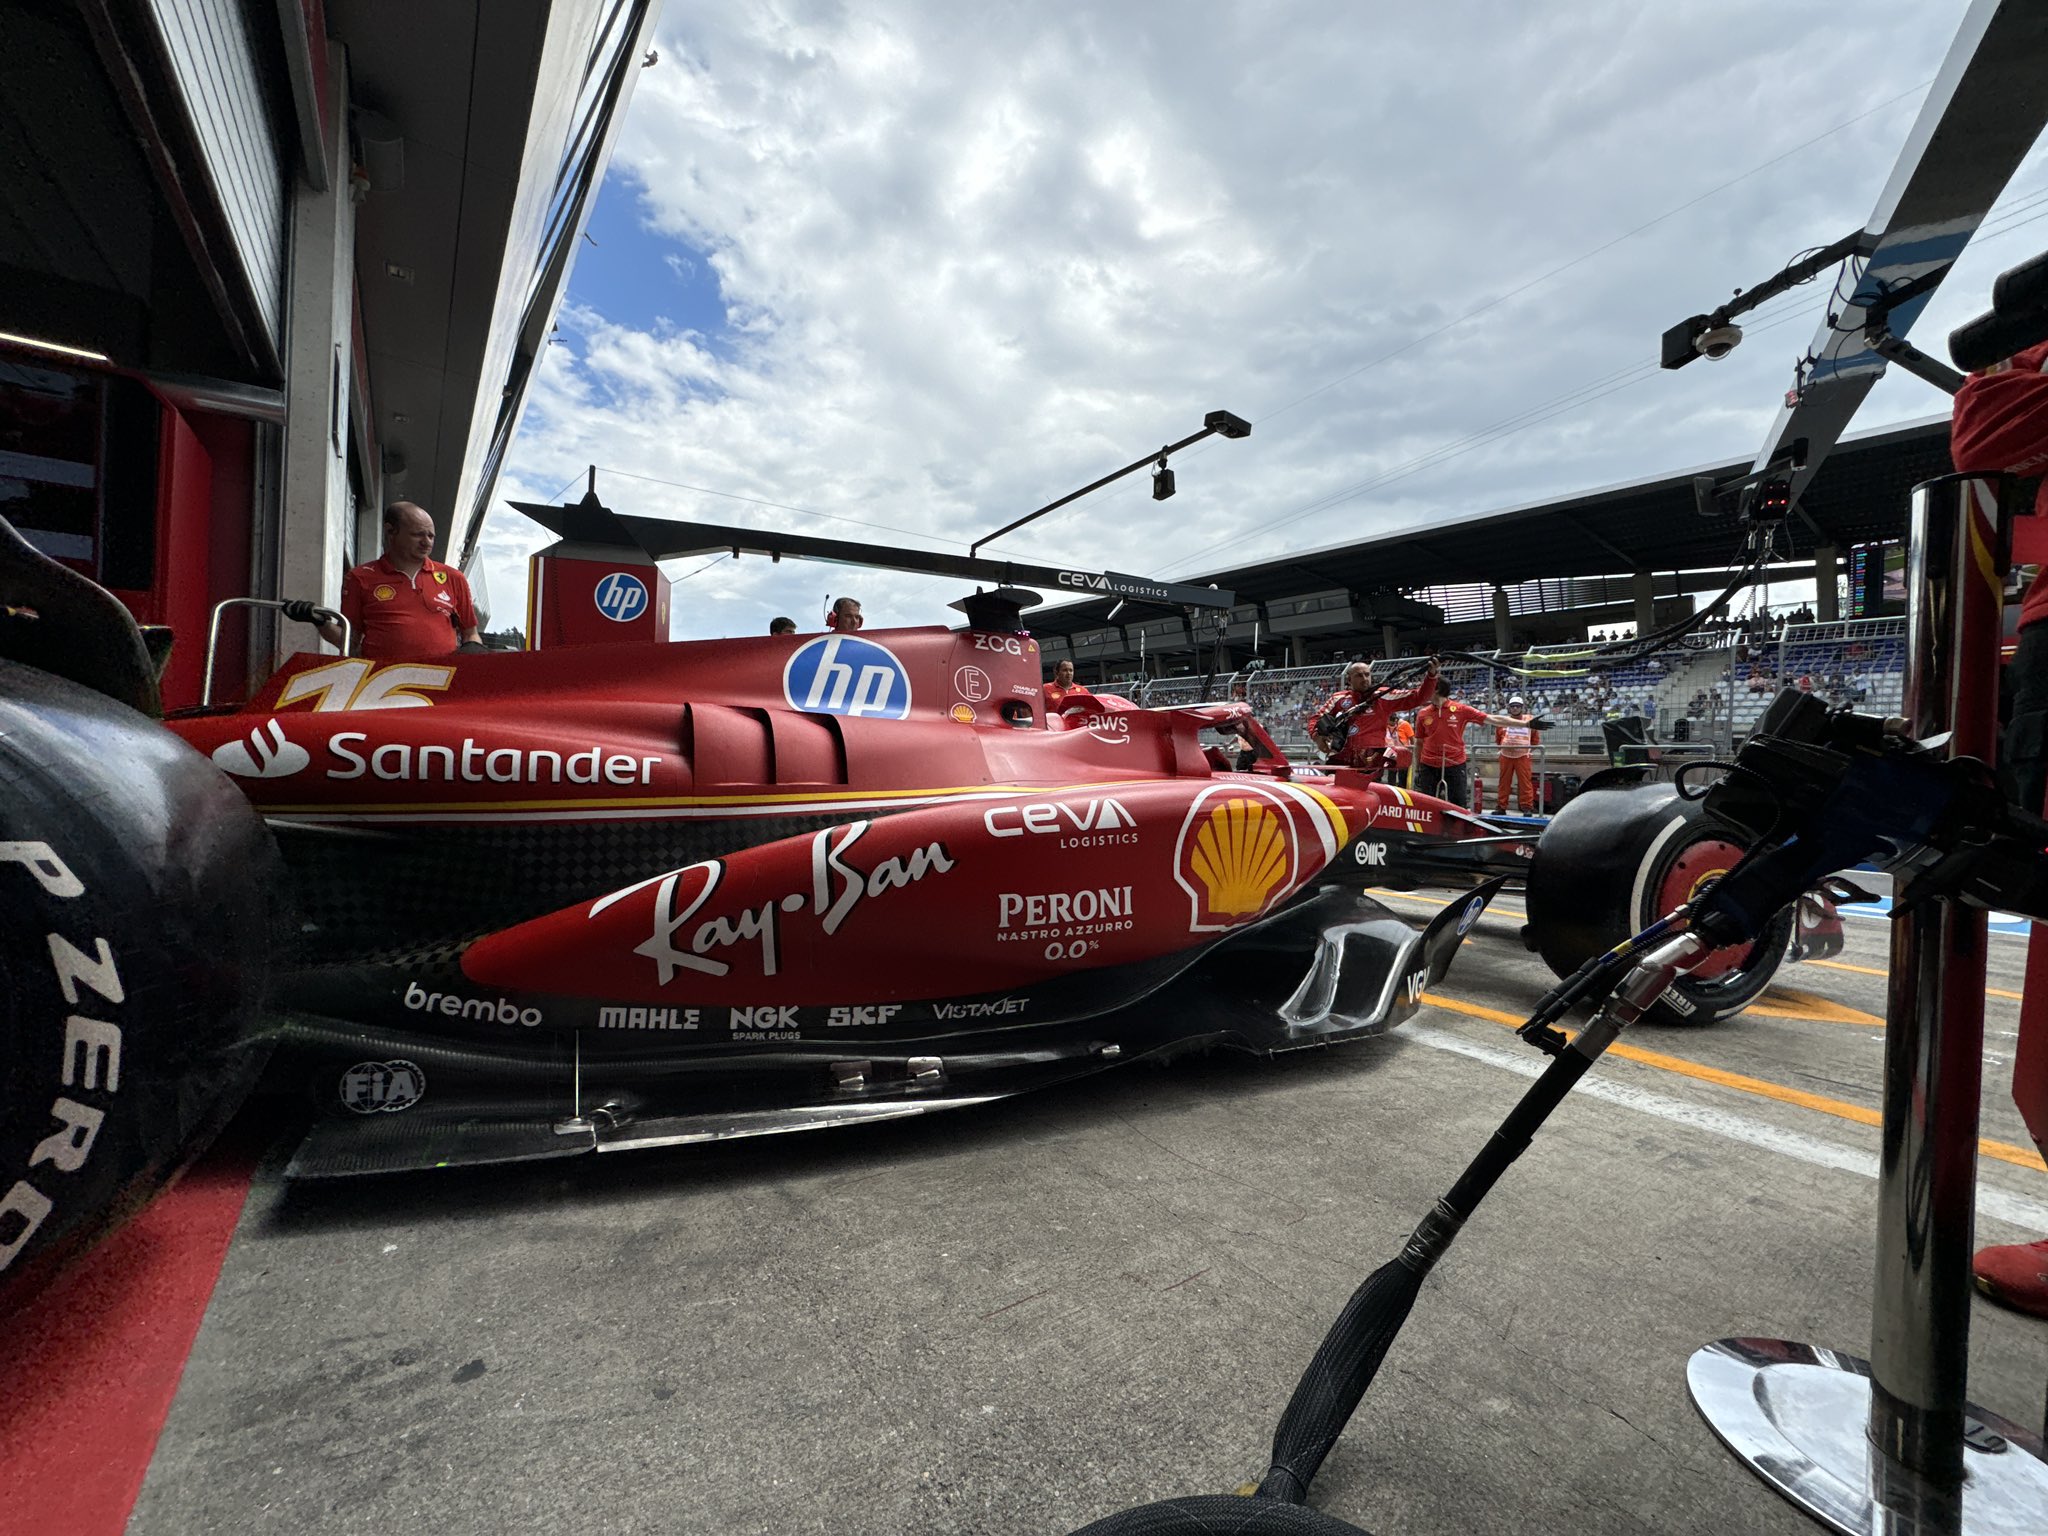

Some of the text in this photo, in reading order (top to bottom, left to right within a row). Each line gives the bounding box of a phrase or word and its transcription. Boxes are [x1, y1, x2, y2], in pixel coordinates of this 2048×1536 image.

[601, 573, 643, 621] hp
[1114, 584, 1168, 597] LOGISTICS
[803, 634, 896, 717] hp
[1088, 714, 1129, 733] aws
[326, 732, 662, 785] Santander
[1404, 808, 1433, 823] MILLE
[1060, 833, 1139, 849] LOGISTICS
[998, 886, 1133, 929] PERONI
[997, 919, 1133, 942] NASTRO AZZURRO
[1044, 939, 1100, 960] 0.0%
[404, 981, 543, 1027] brembo
[599, 1007, 700, 1029] MAHLE
[730, 1005, 800, 1030] NGK
[827, 1005, 902, 1027] SKF
[732, 1031, 801, 1041] SPARK PLUGS
[0, 932, 126, 1273] ZERO
